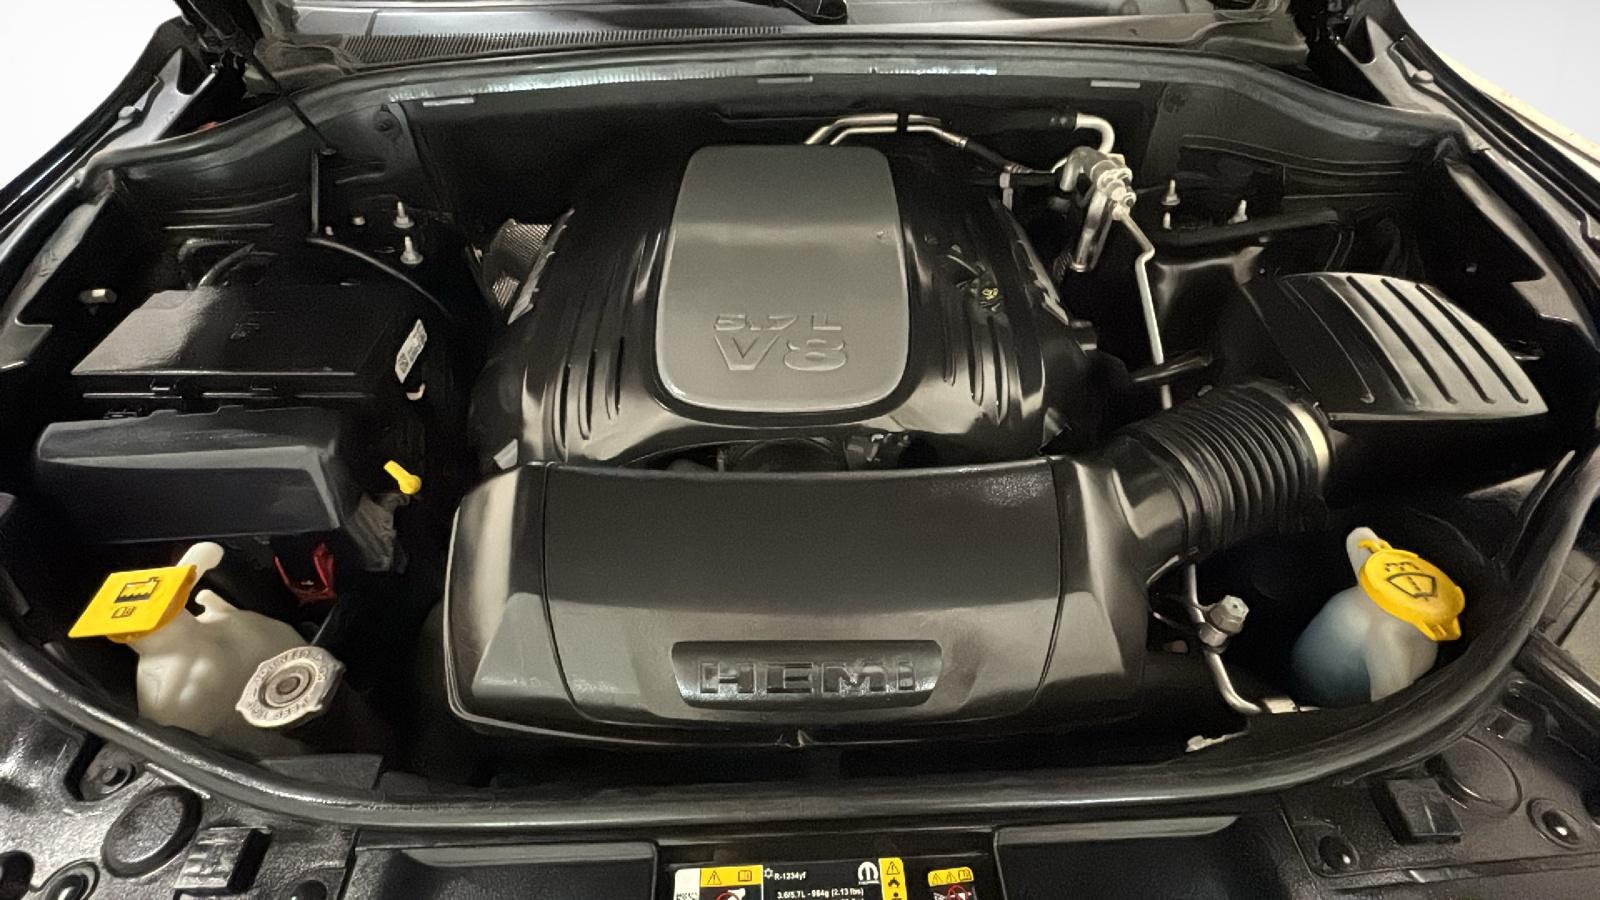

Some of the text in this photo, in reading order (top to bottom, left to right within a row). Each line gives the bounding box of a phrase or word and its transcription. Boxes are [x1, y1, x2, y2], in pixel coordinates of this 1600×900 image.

[714, 335, 847, 371] V8
[699, 659, 916, 695] HEMI
[774, 872, 806, 880] R-1234yf
